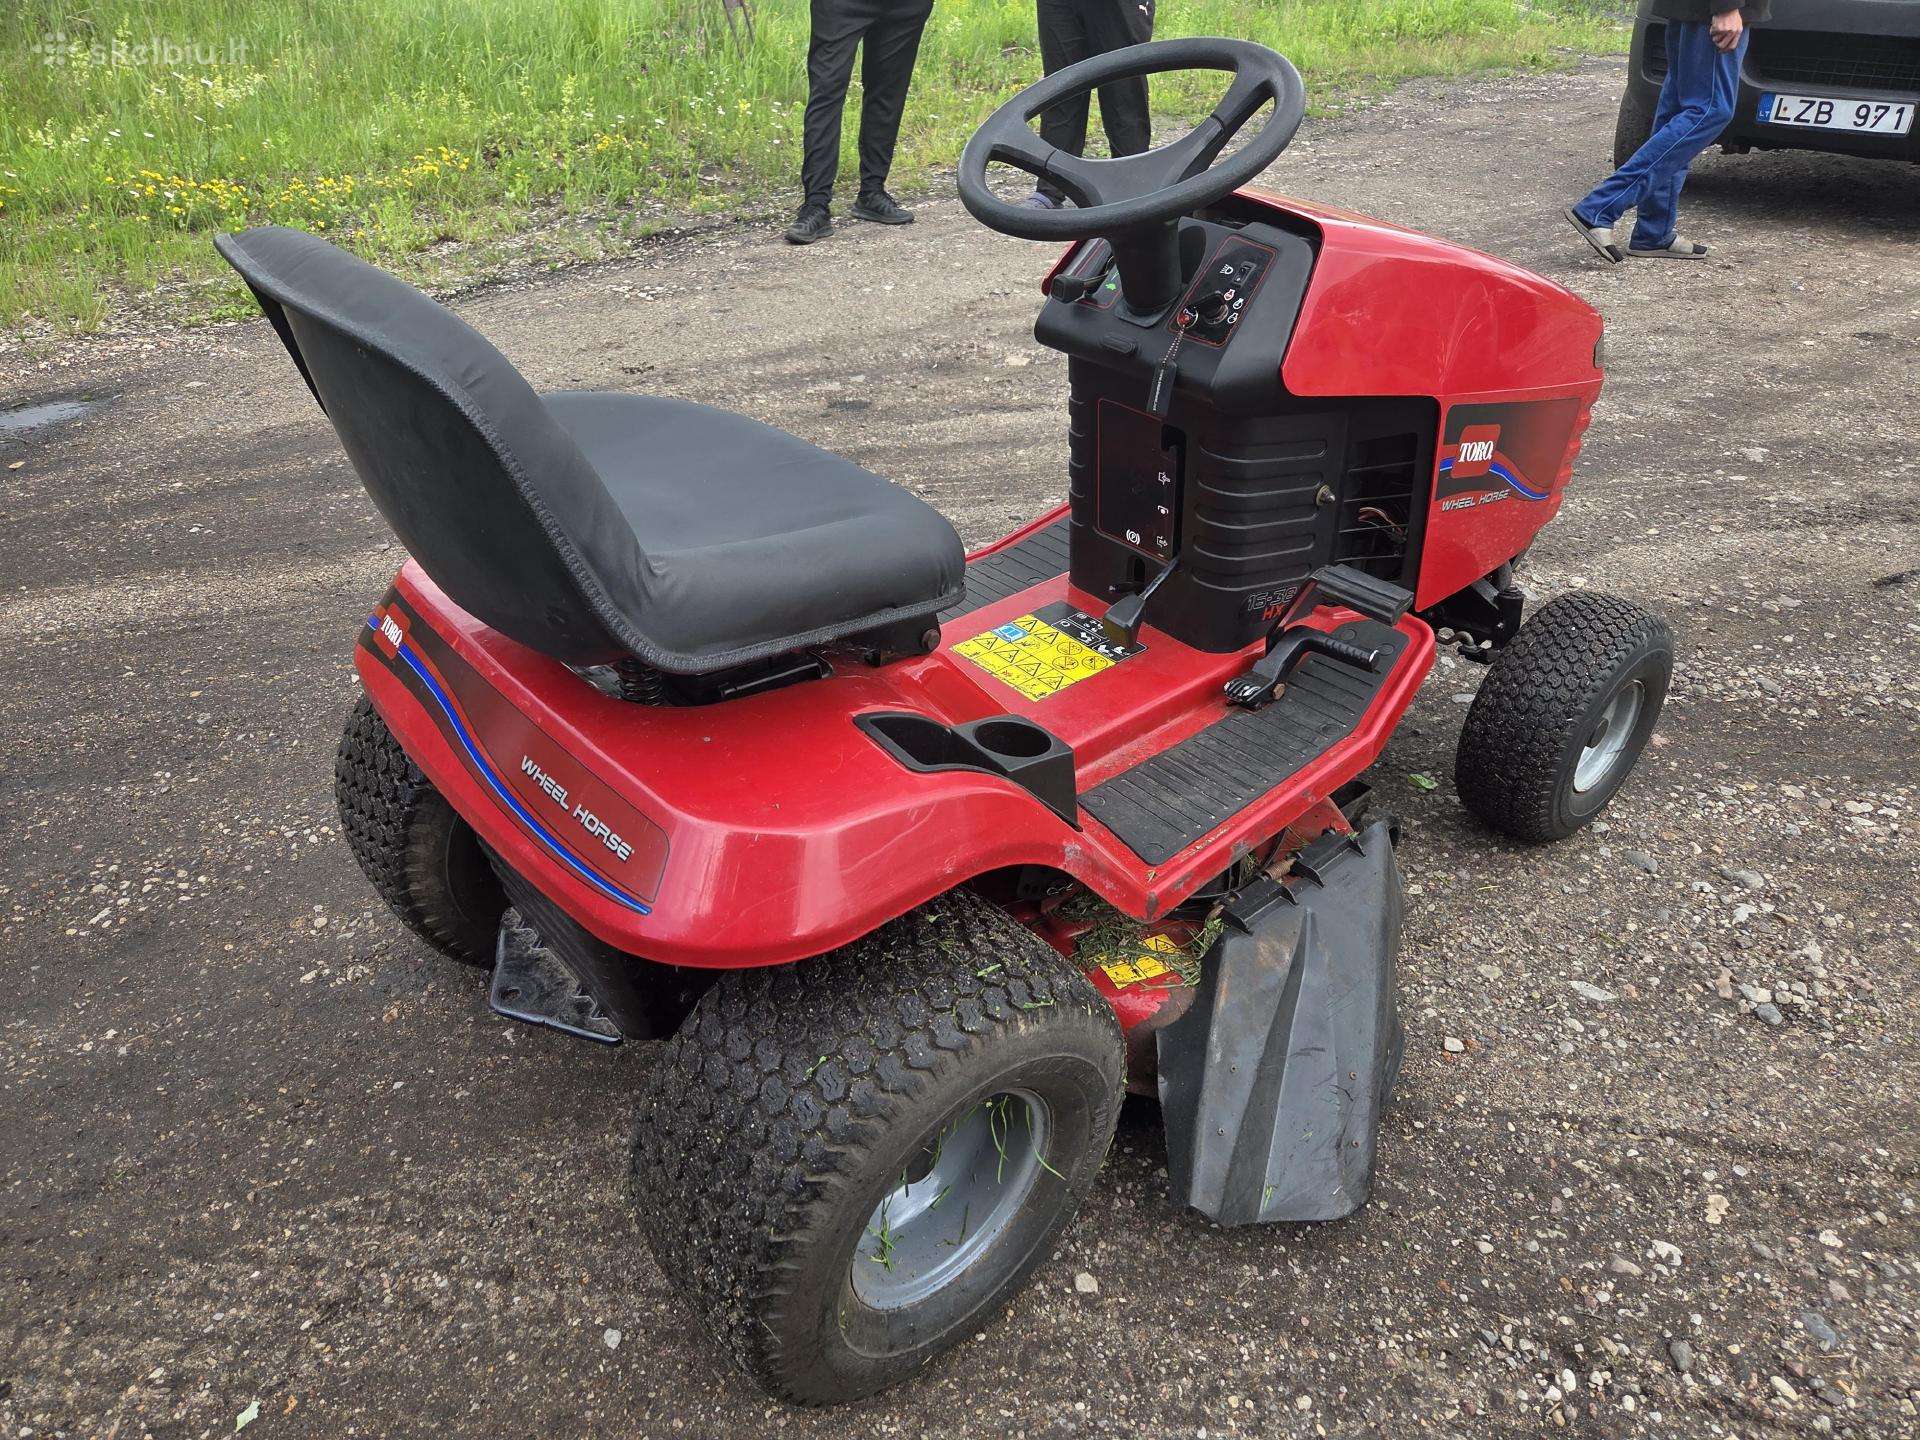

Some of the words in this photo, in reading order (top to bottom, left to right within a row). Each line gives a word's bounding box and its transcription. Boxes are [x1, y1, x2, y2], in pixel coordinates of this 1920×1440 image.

[1774, 97, 1834, 125] LZB
[1853, 104, 1906, 130] 971
[1458, 440, 1494, 463] TORO
[1442, 496, 1476, 512] WHEEL
[1479, 489, 1511, 504] HORSE
[381, 614, 402, 648] TORO
[521, 754, 569, 811] WHEEL
[572, 803, 633, 862] HORSE
